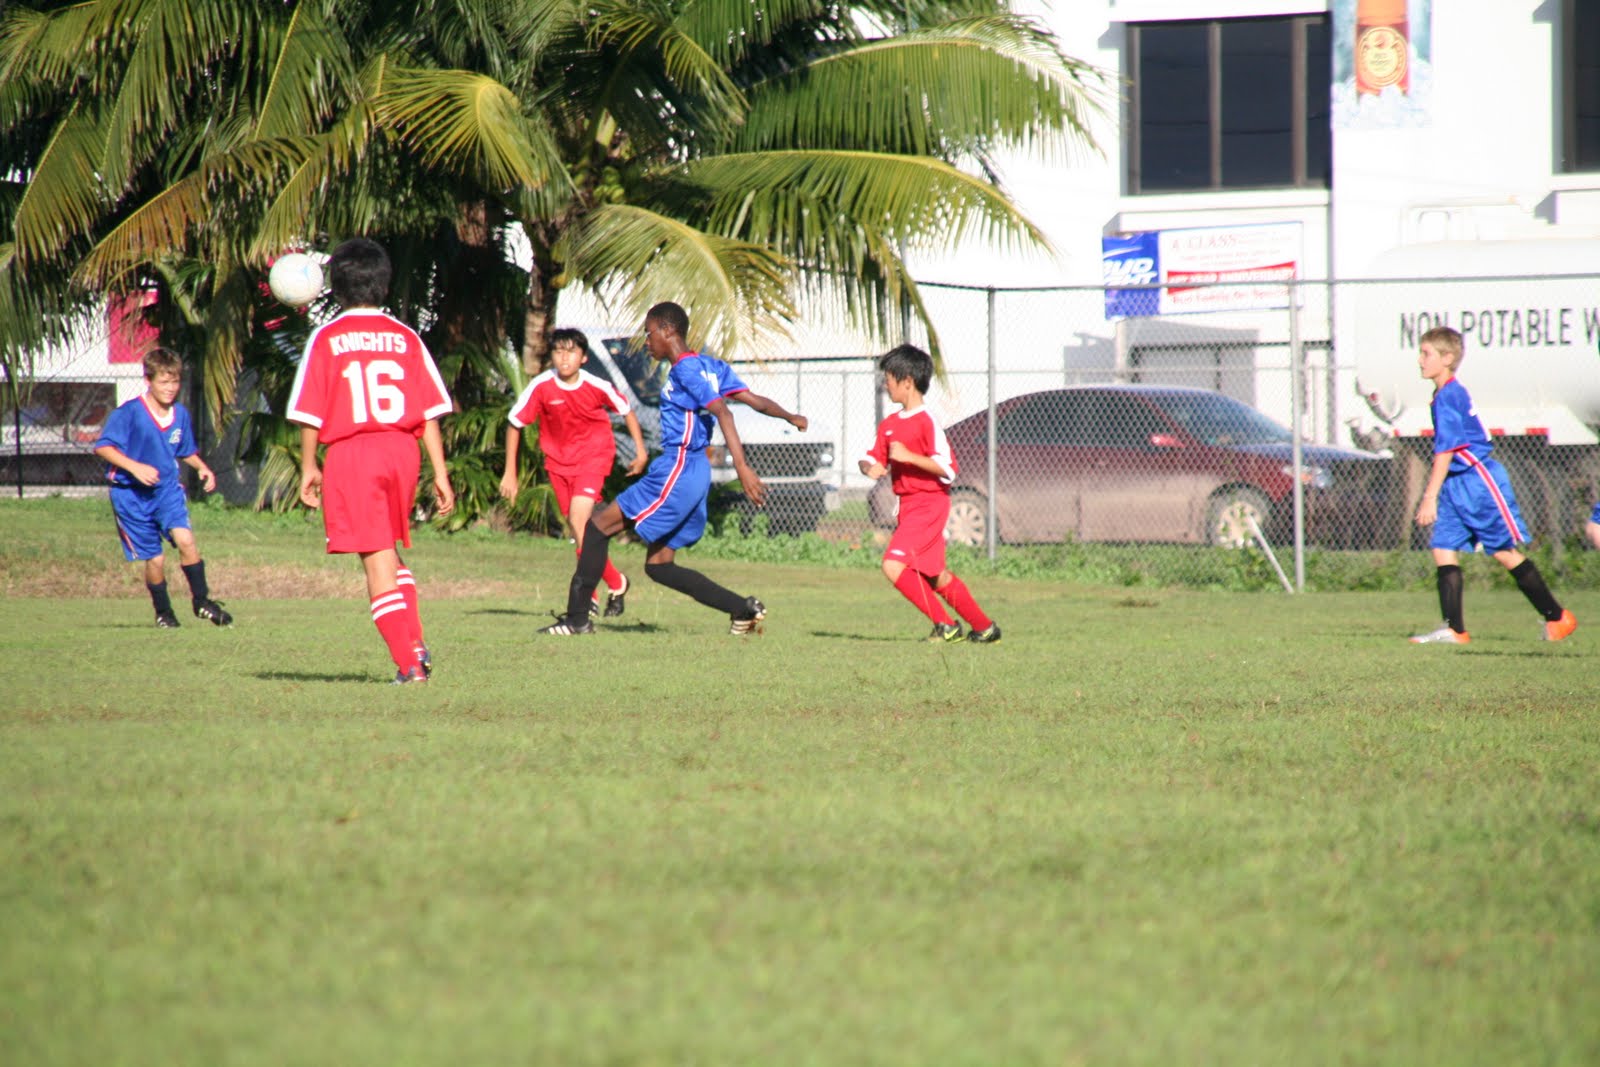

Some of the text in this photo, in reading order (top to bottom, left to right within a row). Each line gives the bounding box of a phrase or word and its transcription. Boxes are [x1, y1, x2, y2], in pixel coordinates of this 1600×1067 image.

[329, 331, 407, 356] KNIGHTS
[1461, 308, 1573, 347] POTABLE
[342, 360, 405, 424] 16
